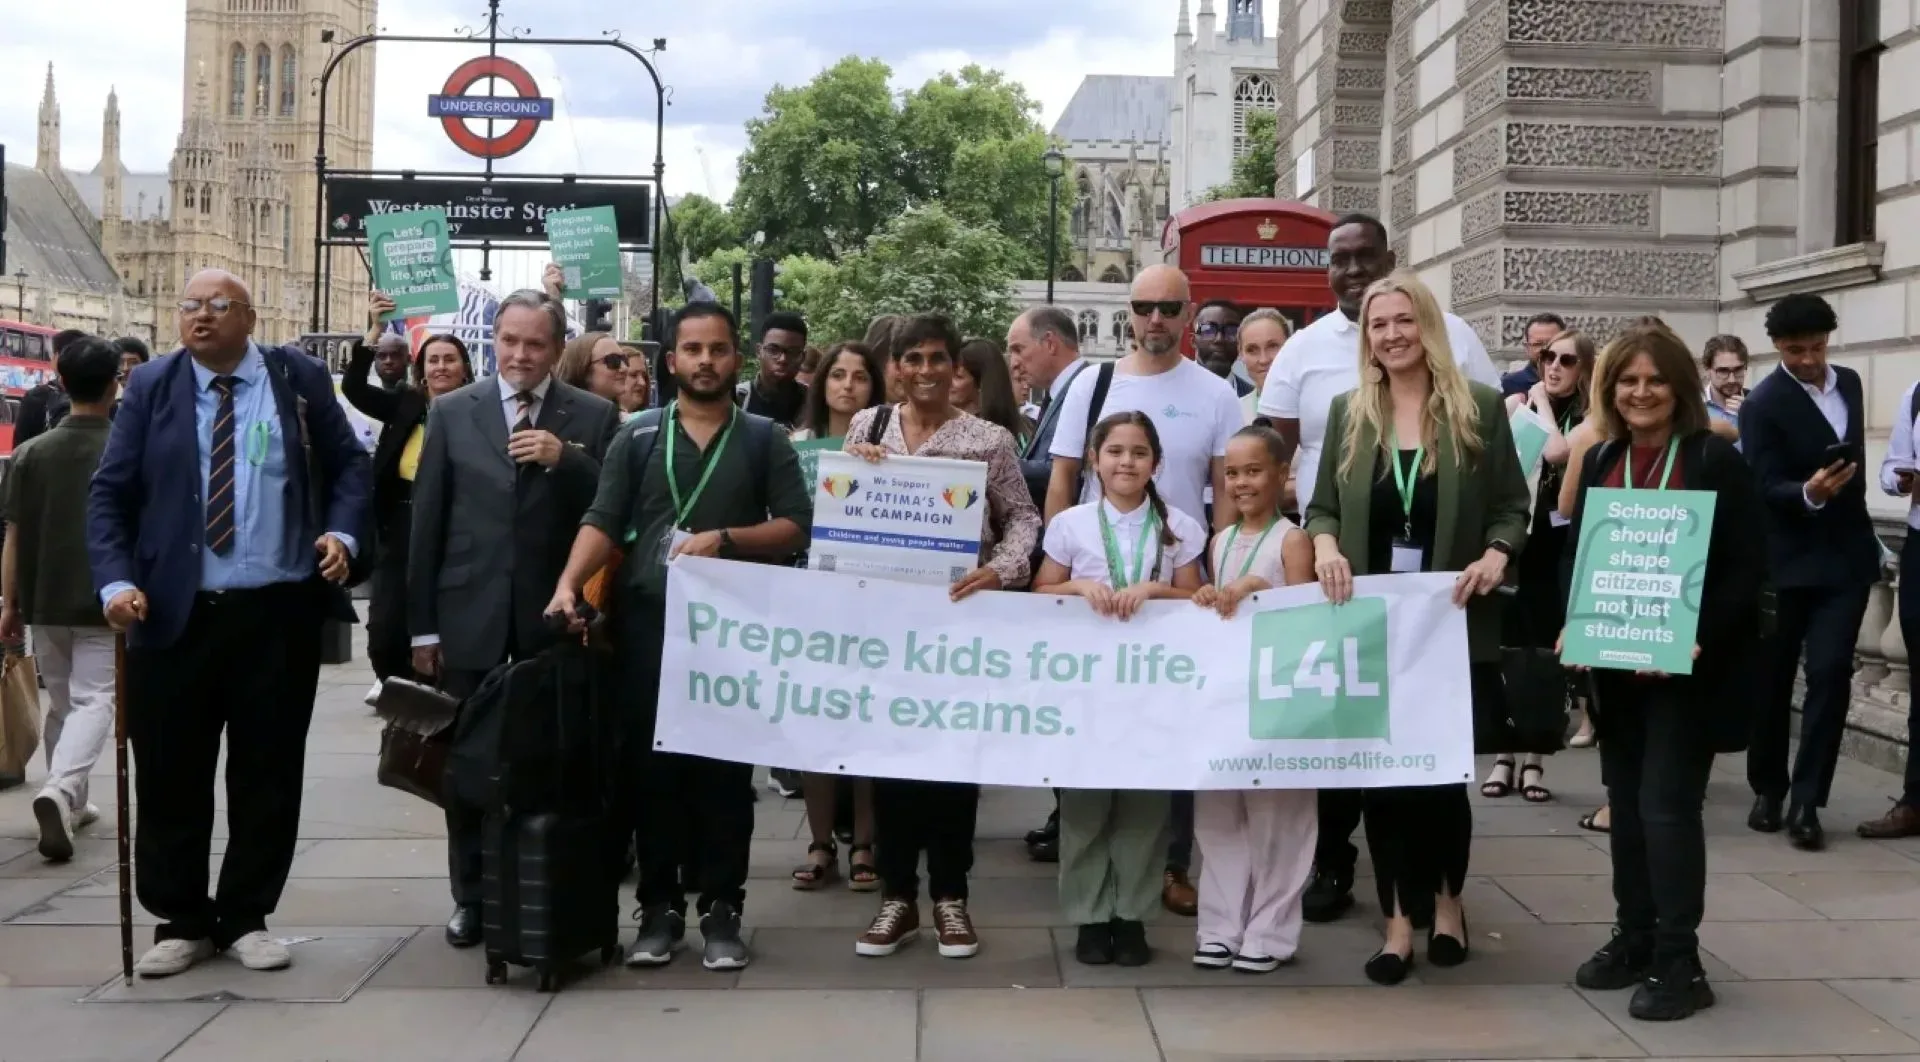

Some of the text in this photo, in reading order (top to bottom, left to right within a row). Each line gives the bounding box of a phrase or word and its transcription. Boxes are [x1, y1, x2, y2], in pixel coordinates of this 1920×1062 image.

[440, 100, 541, 113] UNDERGROUND
[368, 199, 515, 219] Westinster
[392, 226, 424, 239] Let's
[388, 253, 435, 267] kids for
[1206, 247, 1329, 266] TELEPHONE
[873, 476, 931, 490] We Support
[865, 491, 935, 508] FATIMA'S
[845, 505, 953, 526] UK CAMPAIGN
[1607, 502, 1688, 521] Schools
[828, 530, 965, 550] Children and young people matter
[1609, 525, 1679, 545] should
[1608, 550, 1670, 571] shape
[1595, 573, 1677, 596] citizens,
[1594, 600, 1672, 619] not just
[1584, 623, 1674, 643] students
[687, 600, 1207, 691] Prepare kids for life,
[1257, 637, 1381, 701] L4L
[688, 669, 1076, 737] not just exams.
[1208, 751, 1437, 773] www.lessons4life.org
